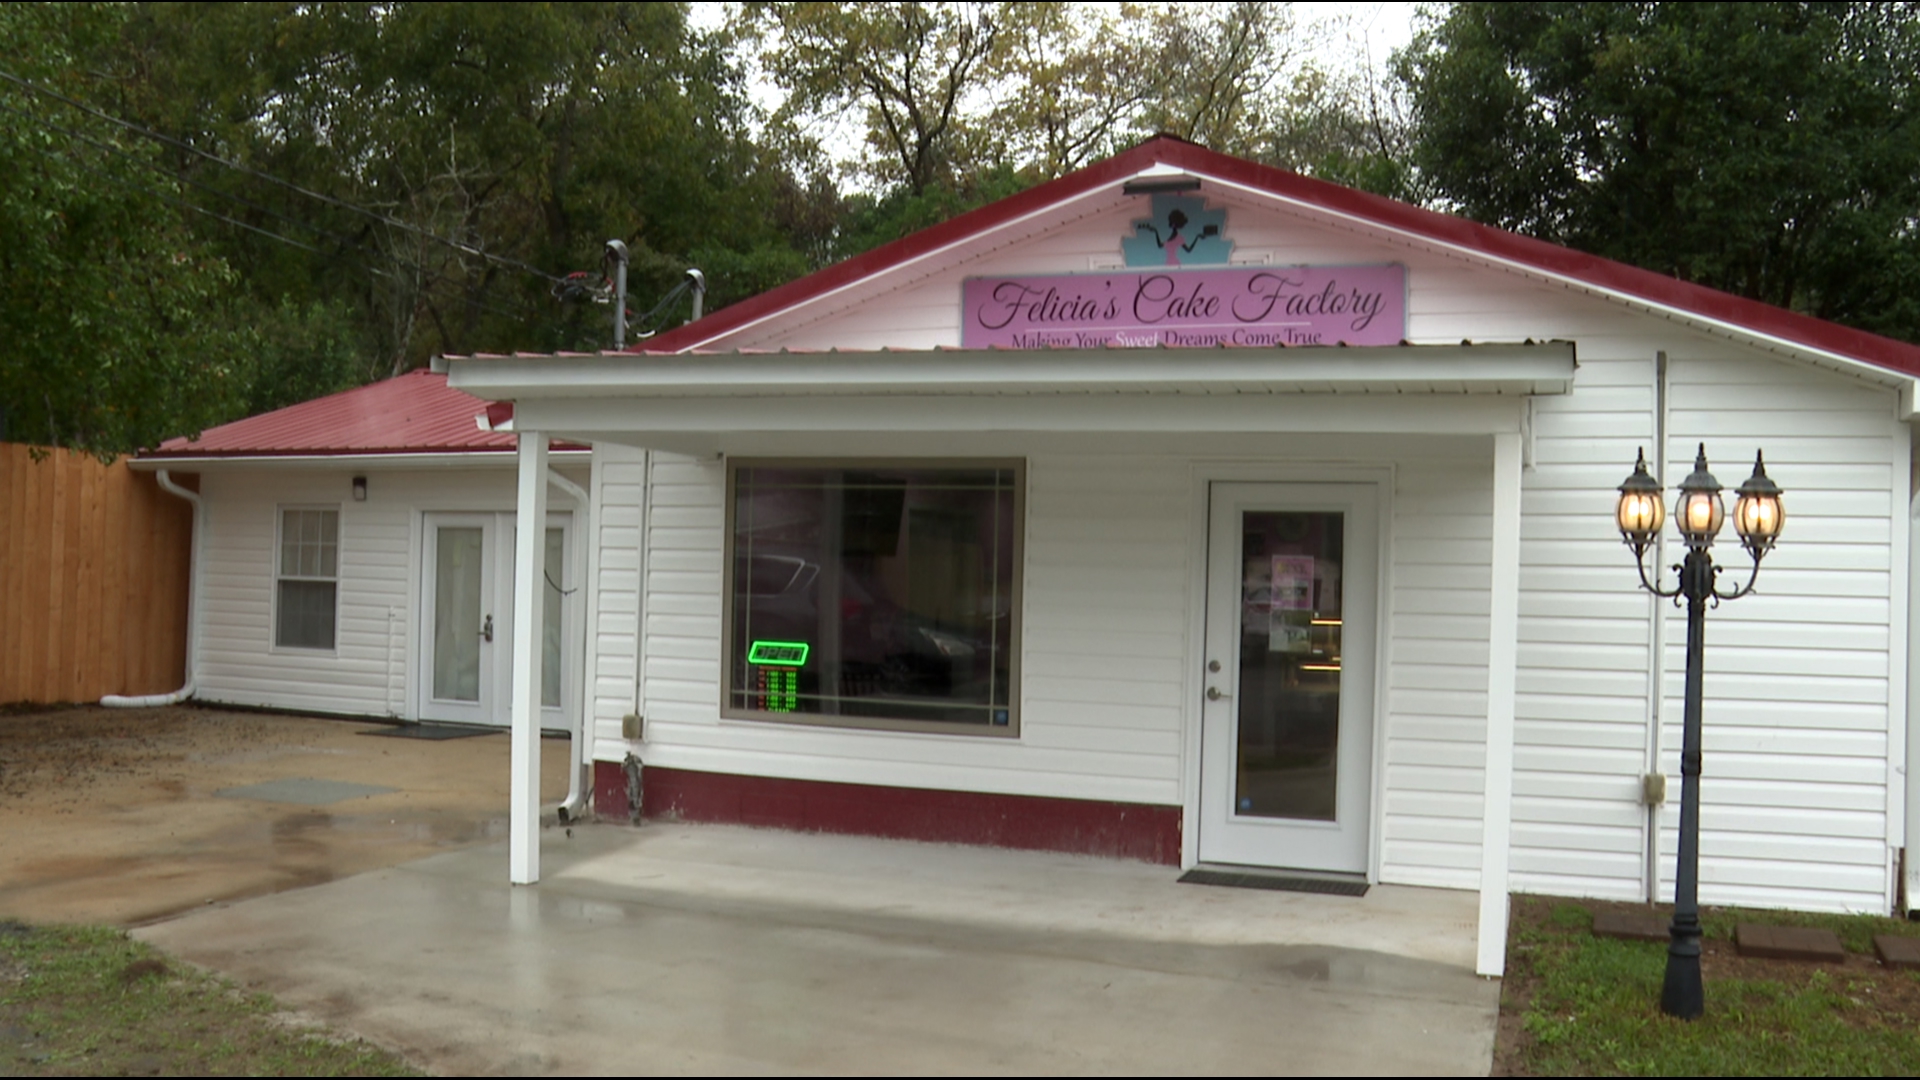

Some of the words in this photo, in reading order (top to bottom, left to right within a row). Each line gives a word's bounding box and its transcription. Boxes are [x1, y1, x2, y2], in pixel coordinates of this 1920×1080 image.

[978, 279, 1120, 330] Felicia's
[1133, 274, 1220, 324] Cake
[1231, 272, 1387, 333] Factory
[1075, 332, 1112, 349] Your
[1115, 331, 1159, 347] Sweet
[1164, 330, 1228, 346] Dreams
[1232, 328, 1281, 345] Come
[1284, 327, 1322, 345] True
[754, 646, 803, 660] OPEN
